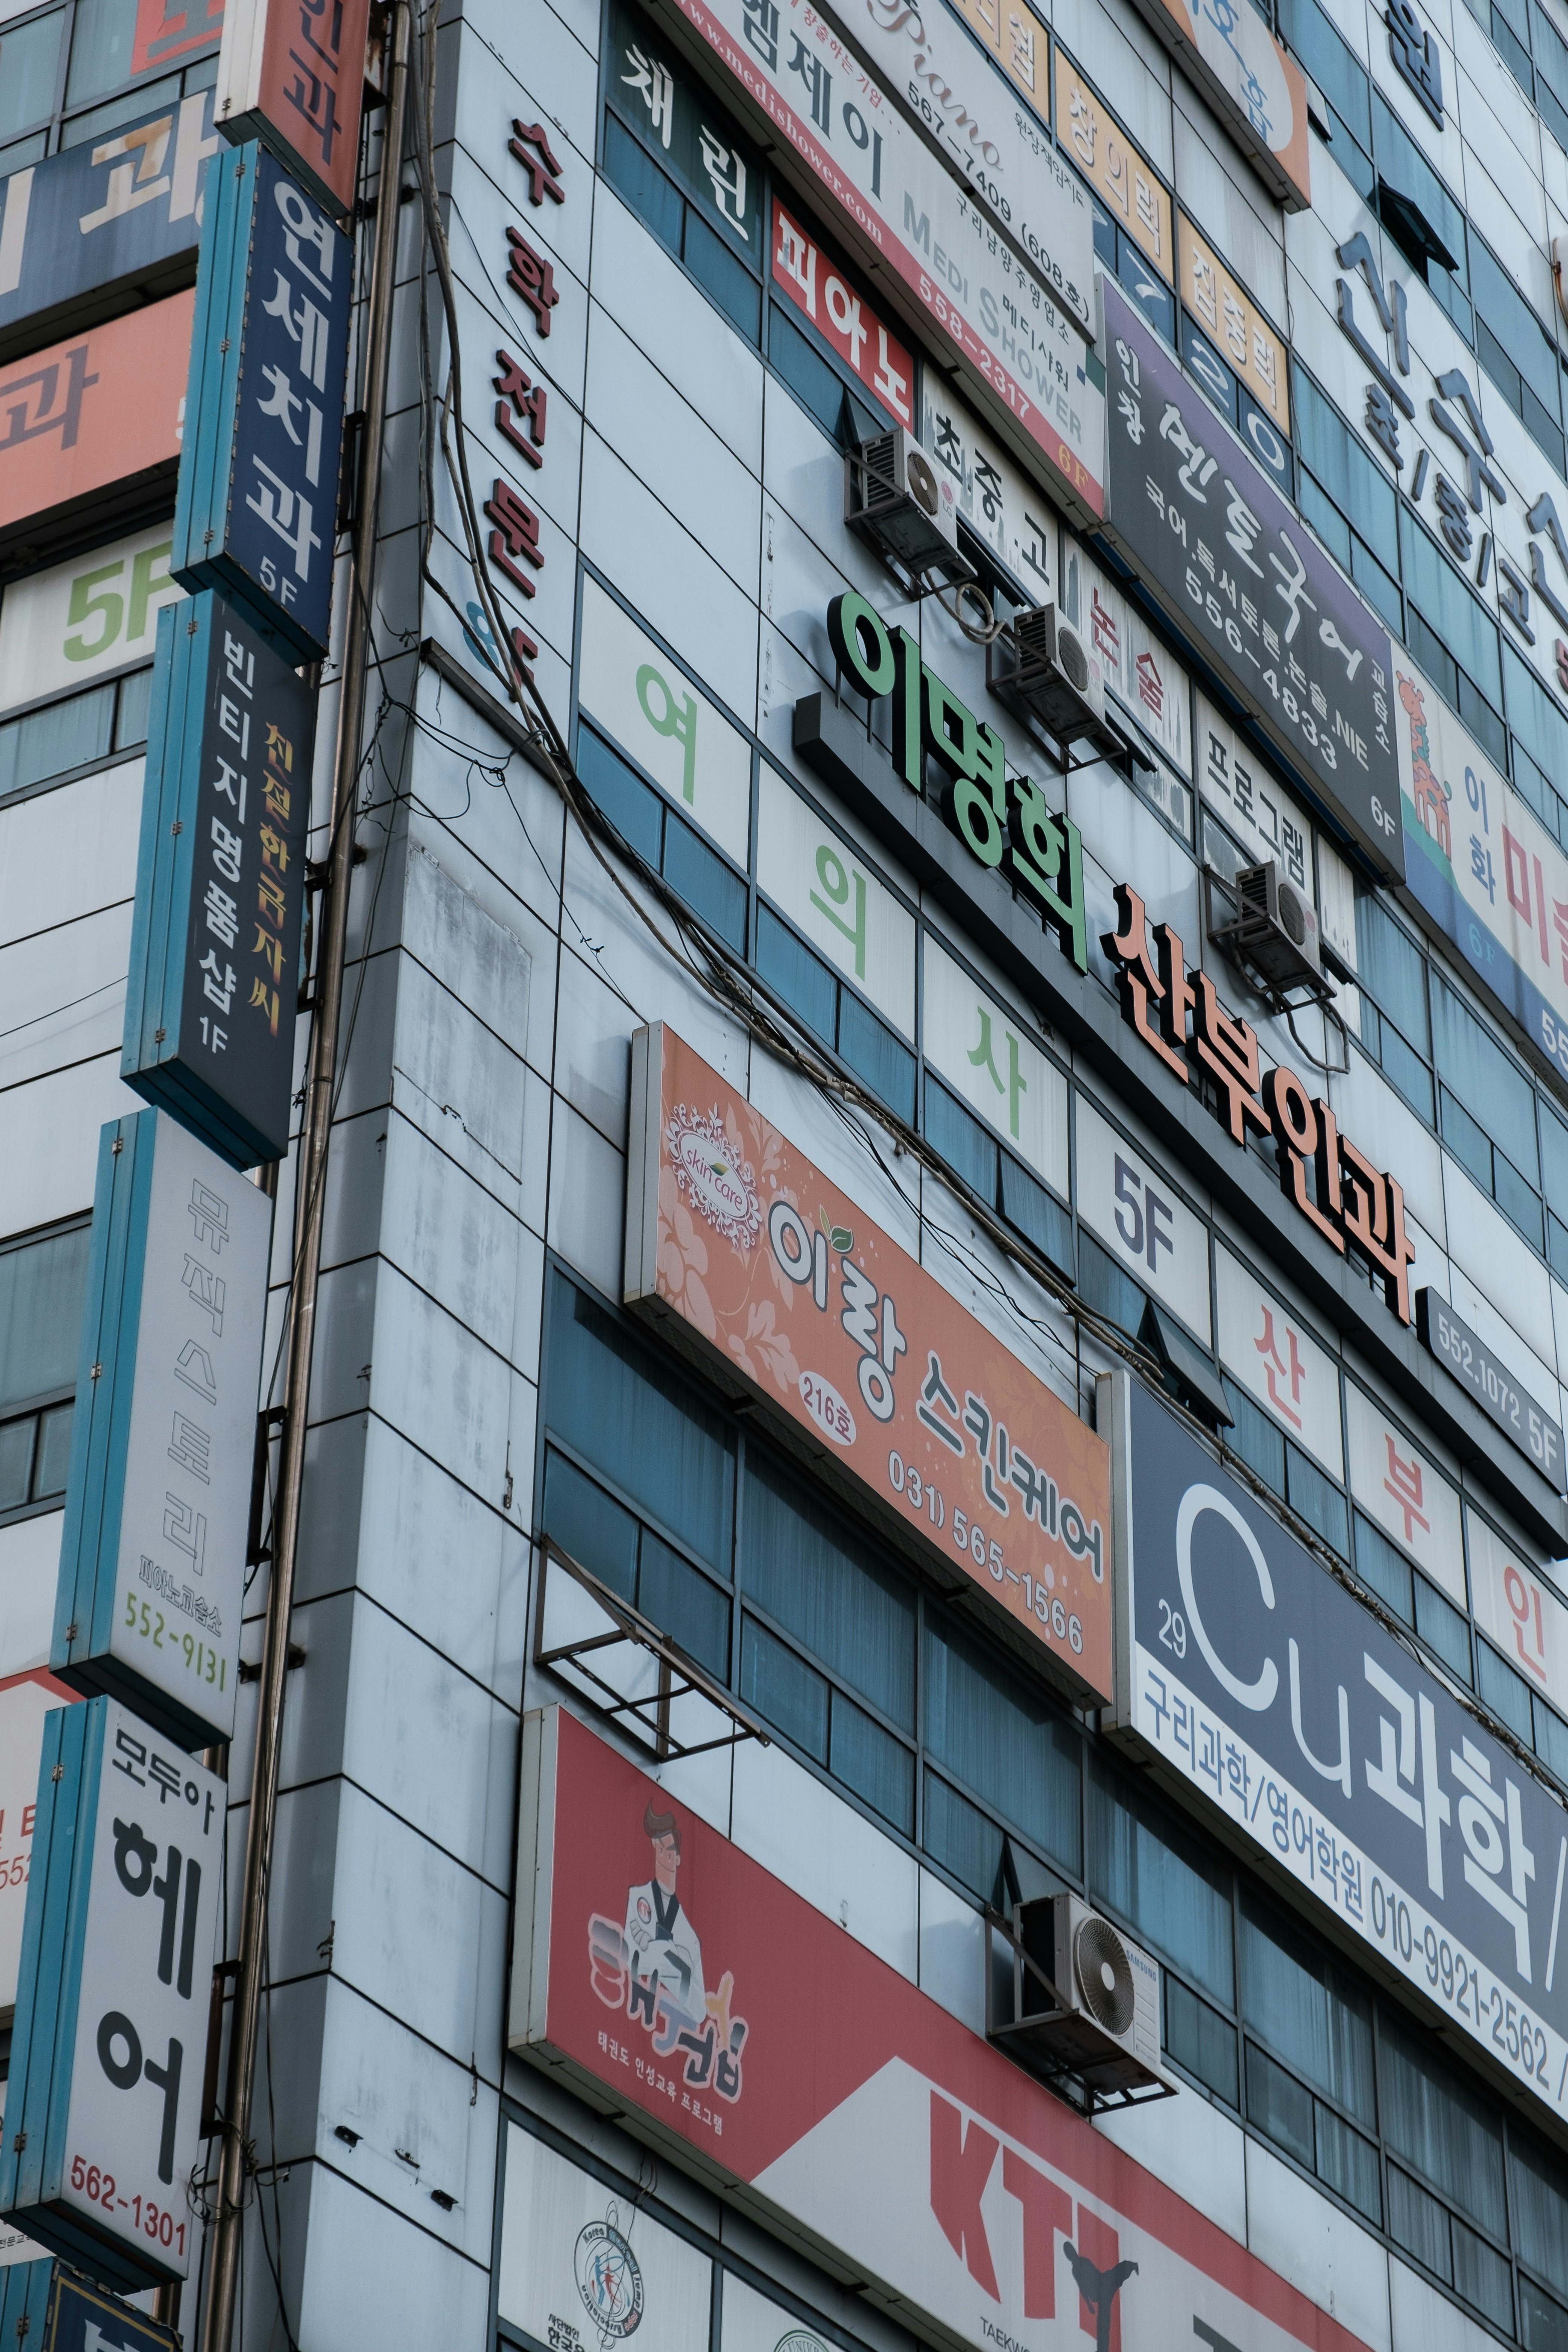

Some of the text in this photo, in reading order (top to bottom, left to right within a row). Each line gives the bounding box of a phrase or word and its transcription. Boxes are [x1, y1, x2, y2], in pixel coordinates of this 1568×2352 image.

[677, 0, 883, 246] ww.medishower.com
[908, 80, 1089, 323] 567-7409 (608호)
[1069, 85, 1161, 259] 창의력
[245, 181, 335, 583] 연세치과
[484, 117, 565, 599] 수학전문
[776, 211, 910, 423] 피아노
[904, 190, 1082, 444] MEDI SHOWER
[919, 274, 1089, 488] 558-2317 6F
[1003, 293, 1069, 393] 메디샤워
[1192, 245, 1277, 410] 집중력
[259, 556, 298, 606] 5F
[1115, 338, 1391, 754] 인창 멘토국어 교습소
[1090, 587, 1164, 721] 논술
[1207, 730, 1305, 891] 프로그램
[1185, 567, 1396, 836] 556-4833 6F
[199, 630, 255, 1016] 빈티지명품샵
[1464, 766, 1496, 906] 이화
[199, 1016, 228, 1054] 1F
[828, 591, 1557, 1469] 이명희 산부인과 552.1072 5F
[1468, 923, 1496, 965] 6F
[686, 1149, 743, 1212] skin care
[1114, 1151, 1173, 1274] 5F
[162, 1178, 229, 1577] 뮤직스토리
[768, 1200, 1104, 1583] 이랑 스킨케어
[138, 1554, 221, 1638] 피아노교습소
[802, 1377, 851, 1445] 216호
[952, 1506, 1084, 1655] 565-1566
[125, 1592, 226, 1692] 552-9131
[1159, 1599, 1187, 1659] 29
[112, 1729, 215, 1836] 모두아
[96, 1817, 202, 2186] 헤어
[1125, 1949, 1157, 1982] SAMSUNG
[1371, 1876, 1551, 2090] 010-9921-2562
[598, 2030, 723, 2136] 태권도 인성교육 프로그램
[70, 2154, 186, 2257] 562-1301
[582, 2227, 605, 2244] Korea
